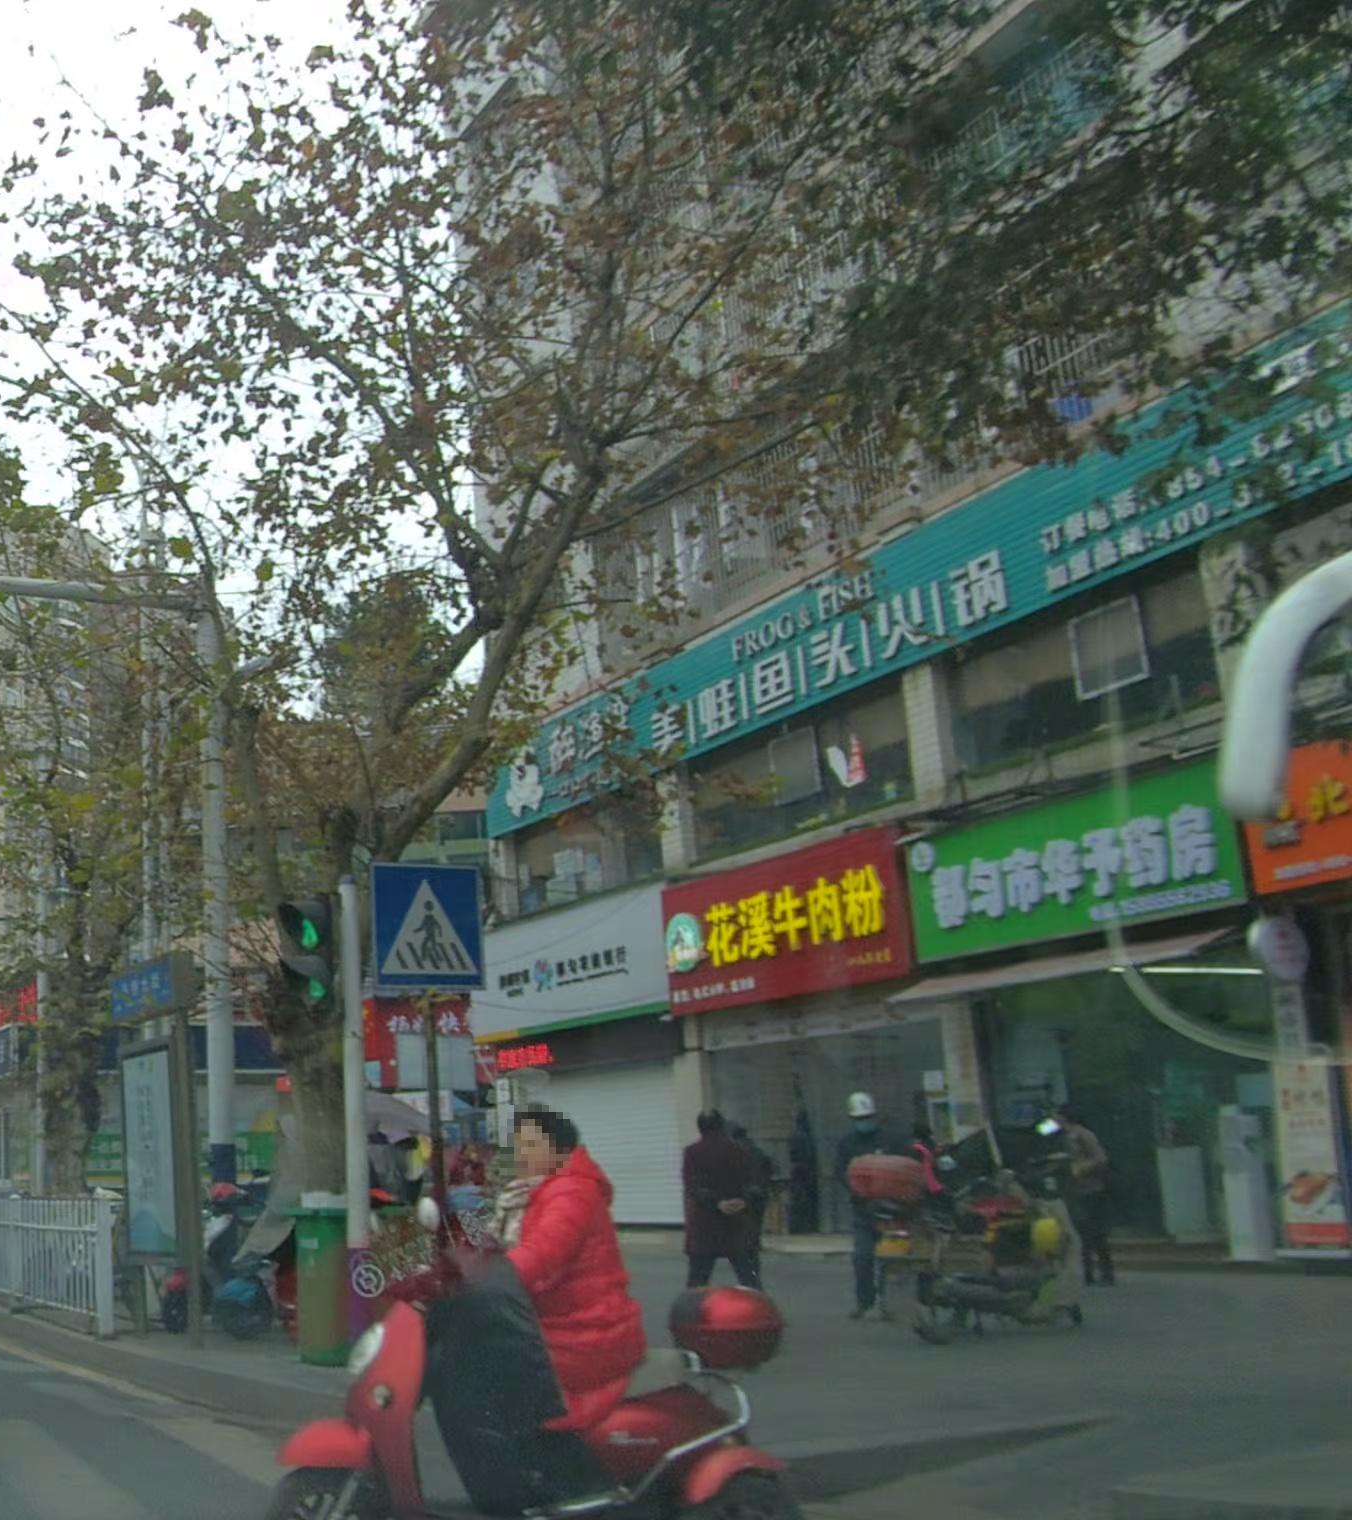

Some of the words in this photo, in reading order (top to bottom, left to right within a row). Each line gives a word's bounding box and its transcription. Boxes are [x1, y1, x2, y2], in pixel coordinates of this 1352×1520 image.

[731, 609, 795, 662] FROG
[817, 568, 877, 622] FISH
[705, 863, 884, 968] 花溪牛肉粉
